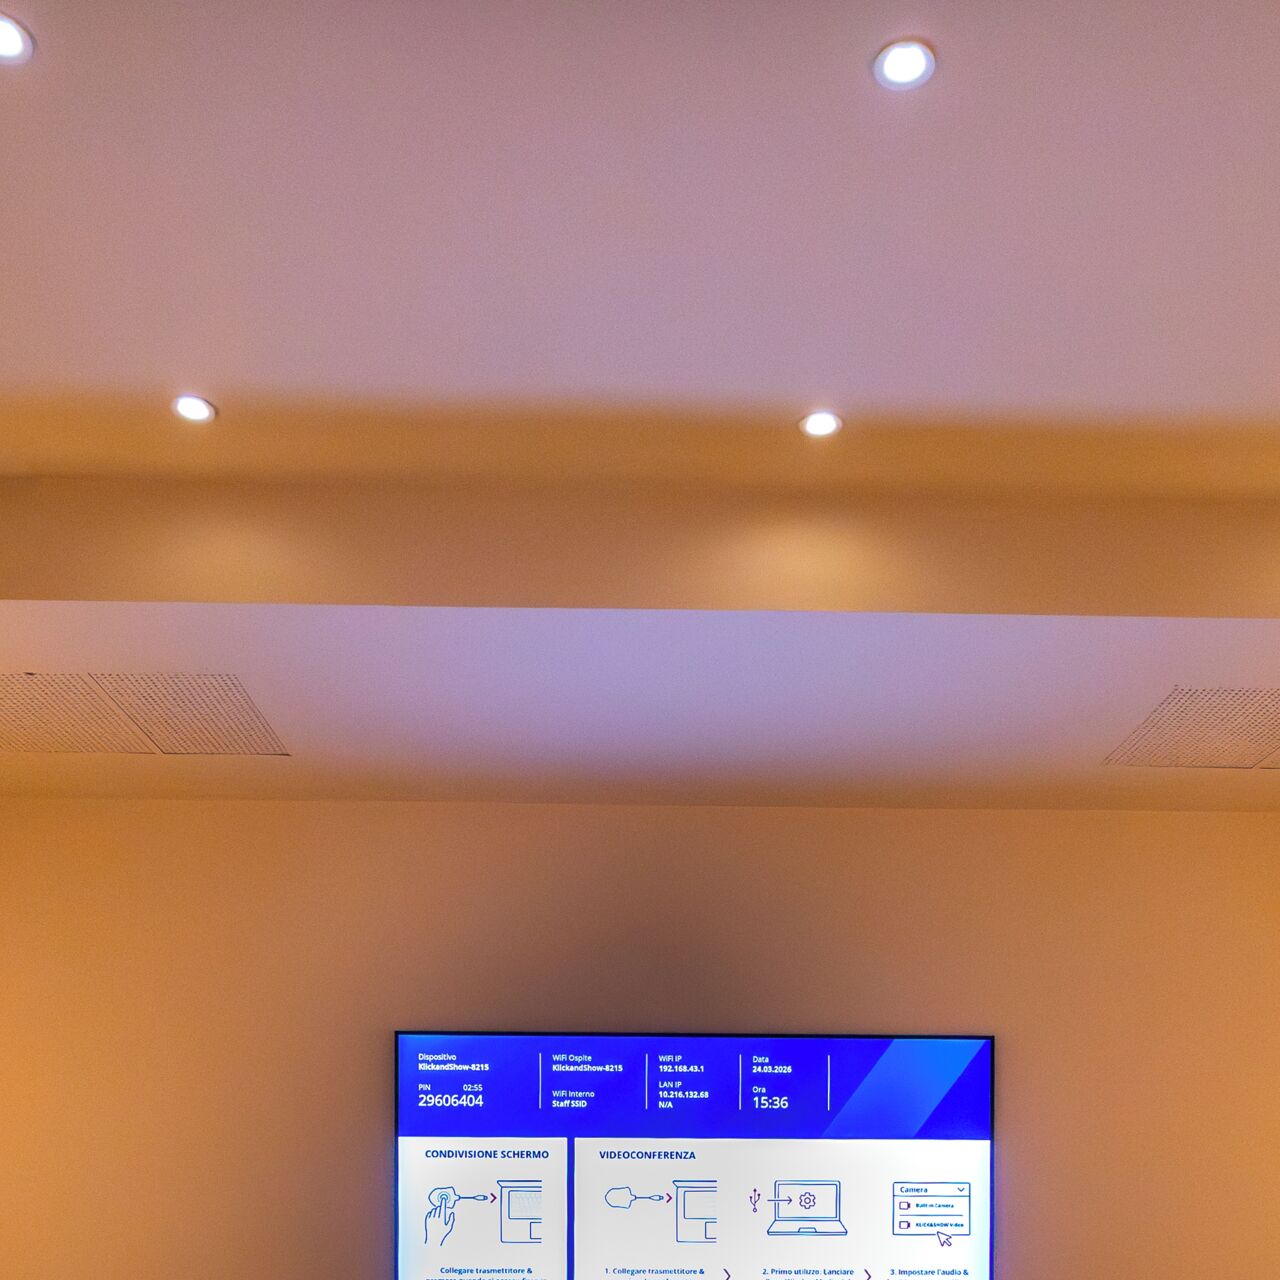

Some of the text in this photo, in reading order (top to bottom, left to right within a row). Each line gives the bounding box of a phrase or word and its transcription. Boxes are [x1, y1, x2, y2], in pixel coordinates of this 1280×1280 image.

[418, 1053, 456, 1062] Dispositivo
[568, 1054, 592, 1063] Ospite
[418, 1094, 484, 1107] 29606404
[753, 1096, 788, 1109] 15:36
[425, 1150, 550, 1159] CONDIVISIONE SCHERMO
[599, 1151, 696, 1160] VIDEOCONFERENZA
